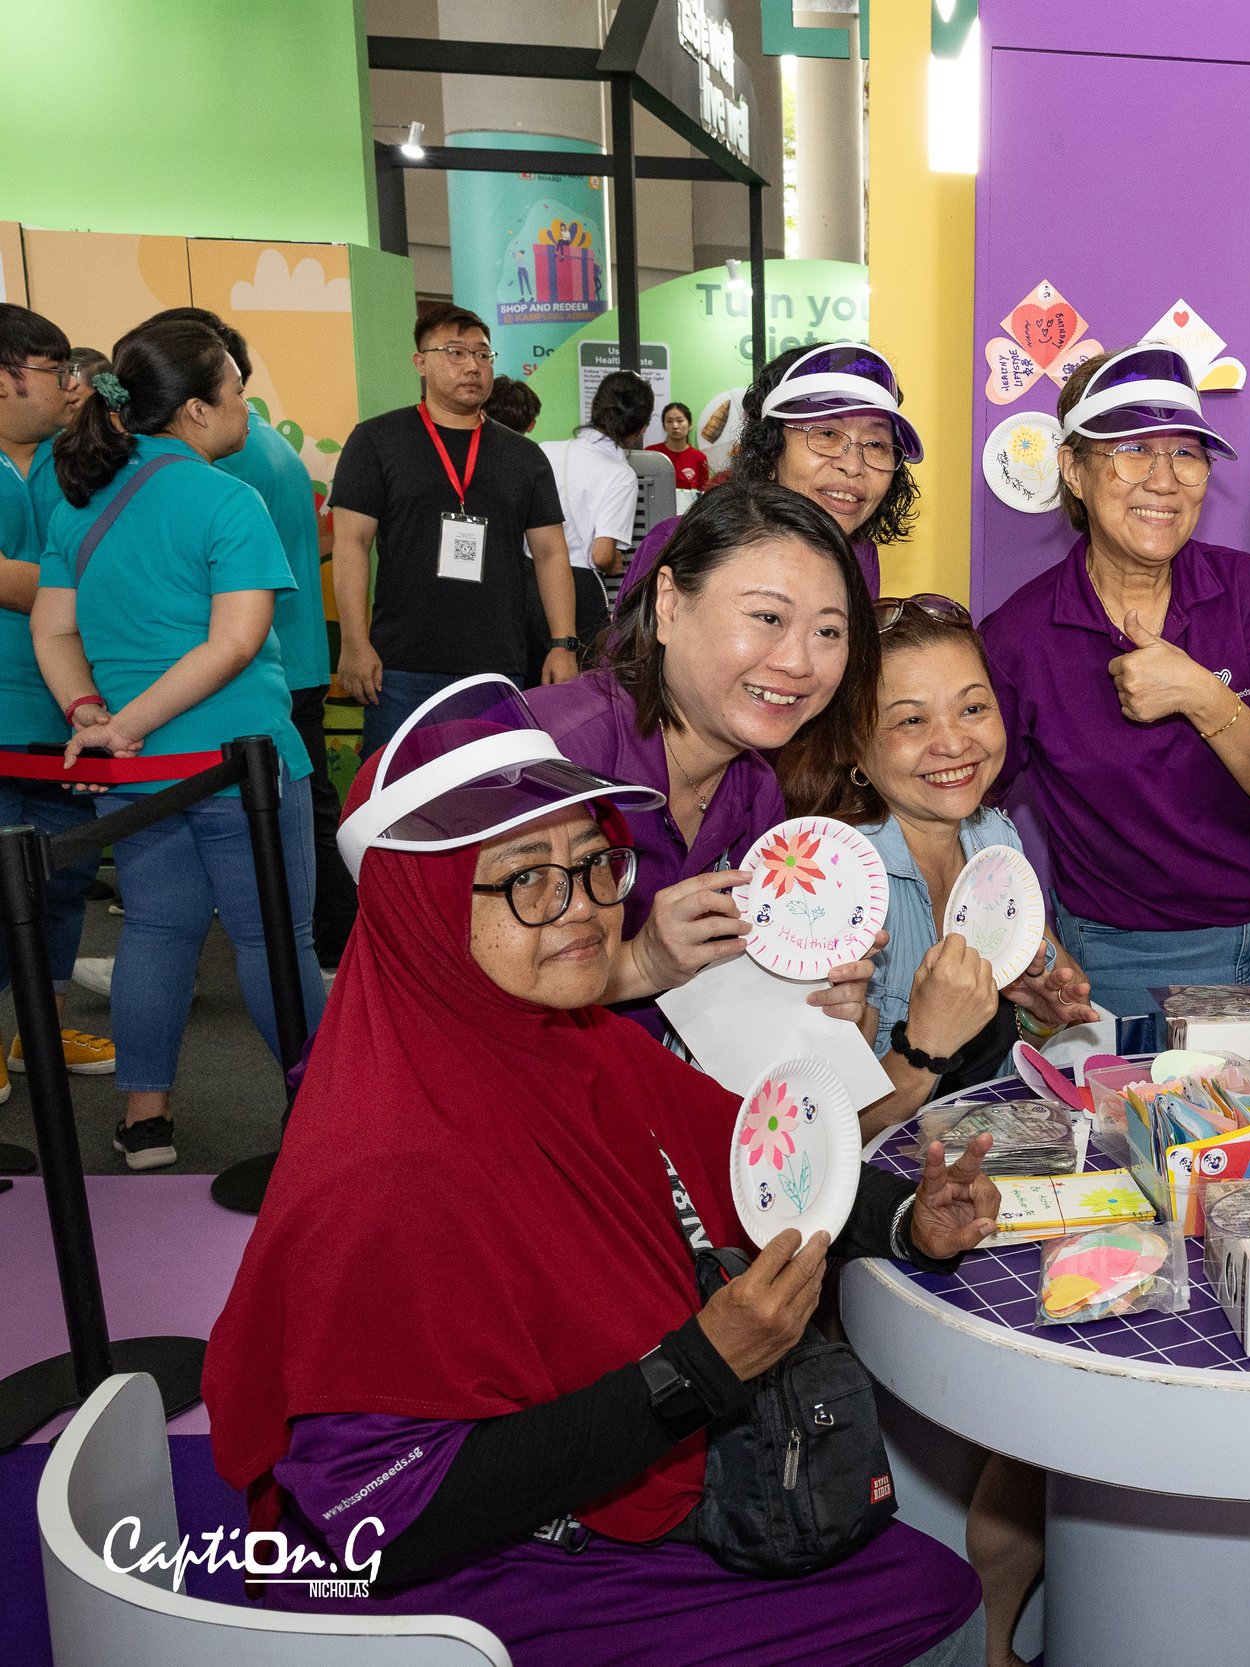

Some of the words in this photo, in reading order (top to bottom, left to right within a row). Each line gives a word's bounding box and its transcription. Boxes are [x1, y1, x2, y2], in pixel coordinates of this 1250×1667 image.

[500, 304, 527, 314] SHOP
[530, 303, 551, 312] AND
[553, 302, 589, 311] REDEEM
[696, 283, 792, 317] Tun
[778, 926, 840, 951] Healthier
[873, 1483, 891, 1501] RIDER
